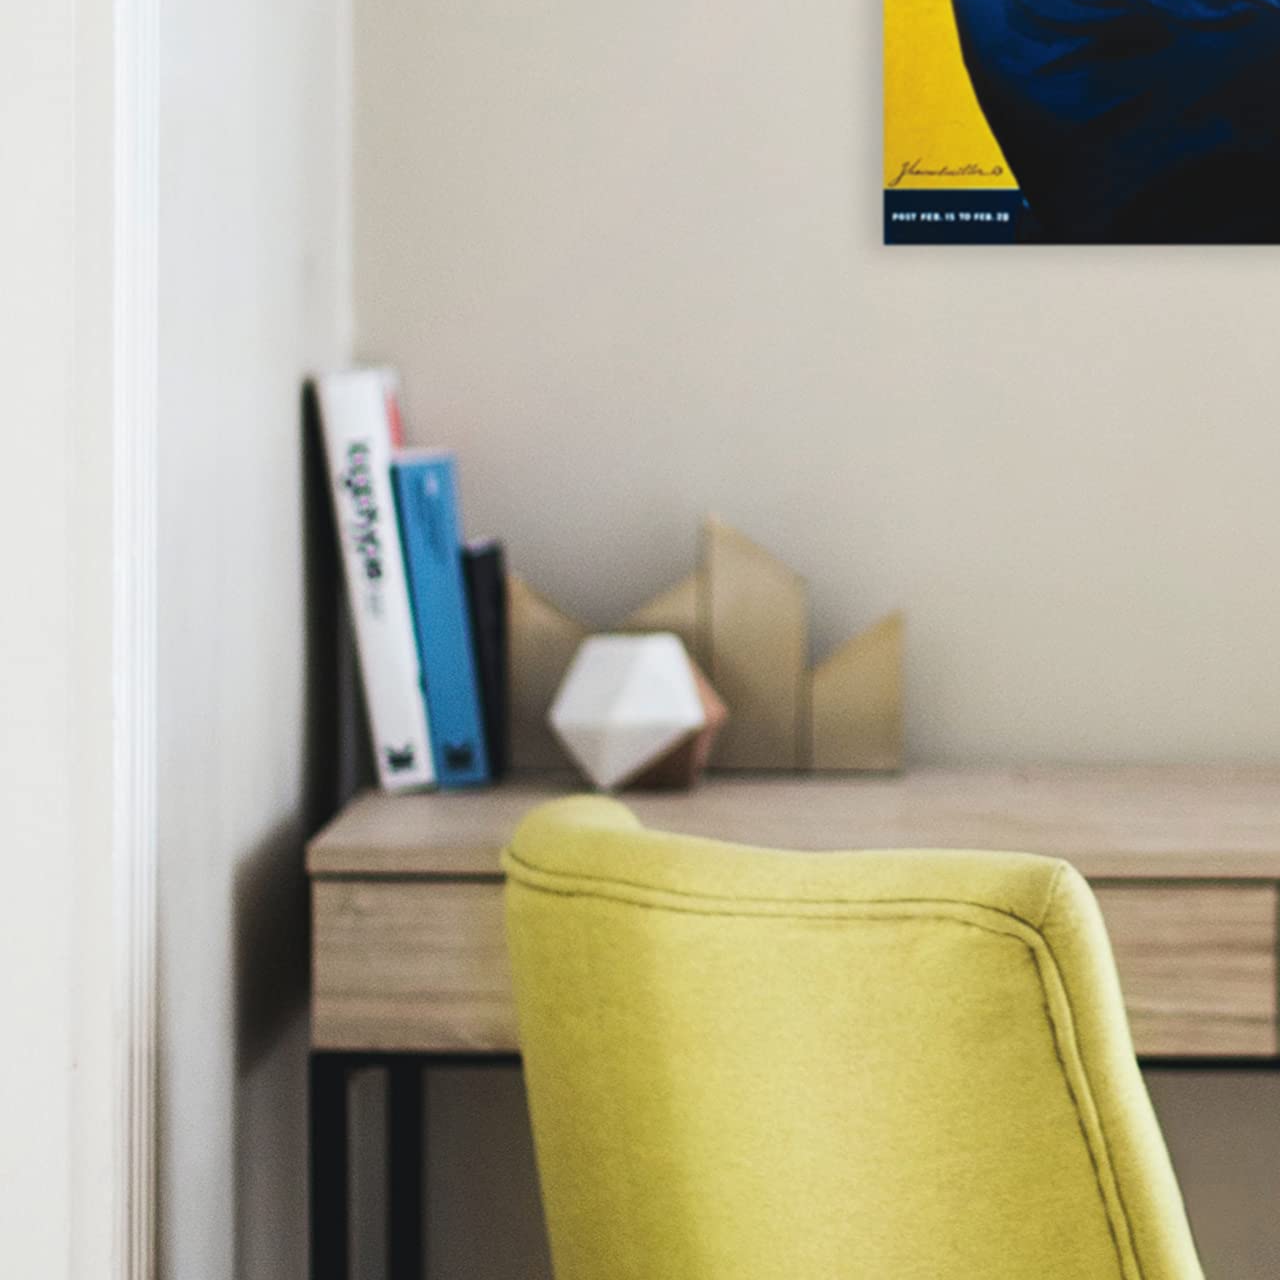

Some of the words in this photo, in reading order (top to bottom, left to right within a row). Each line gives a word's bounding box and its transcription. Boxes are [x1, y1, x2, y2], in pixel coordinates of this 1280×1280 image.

[891, 211, 917, 222] POST
[945, 211, 956, 222] 15
[958, 211, 971, 222] TO
